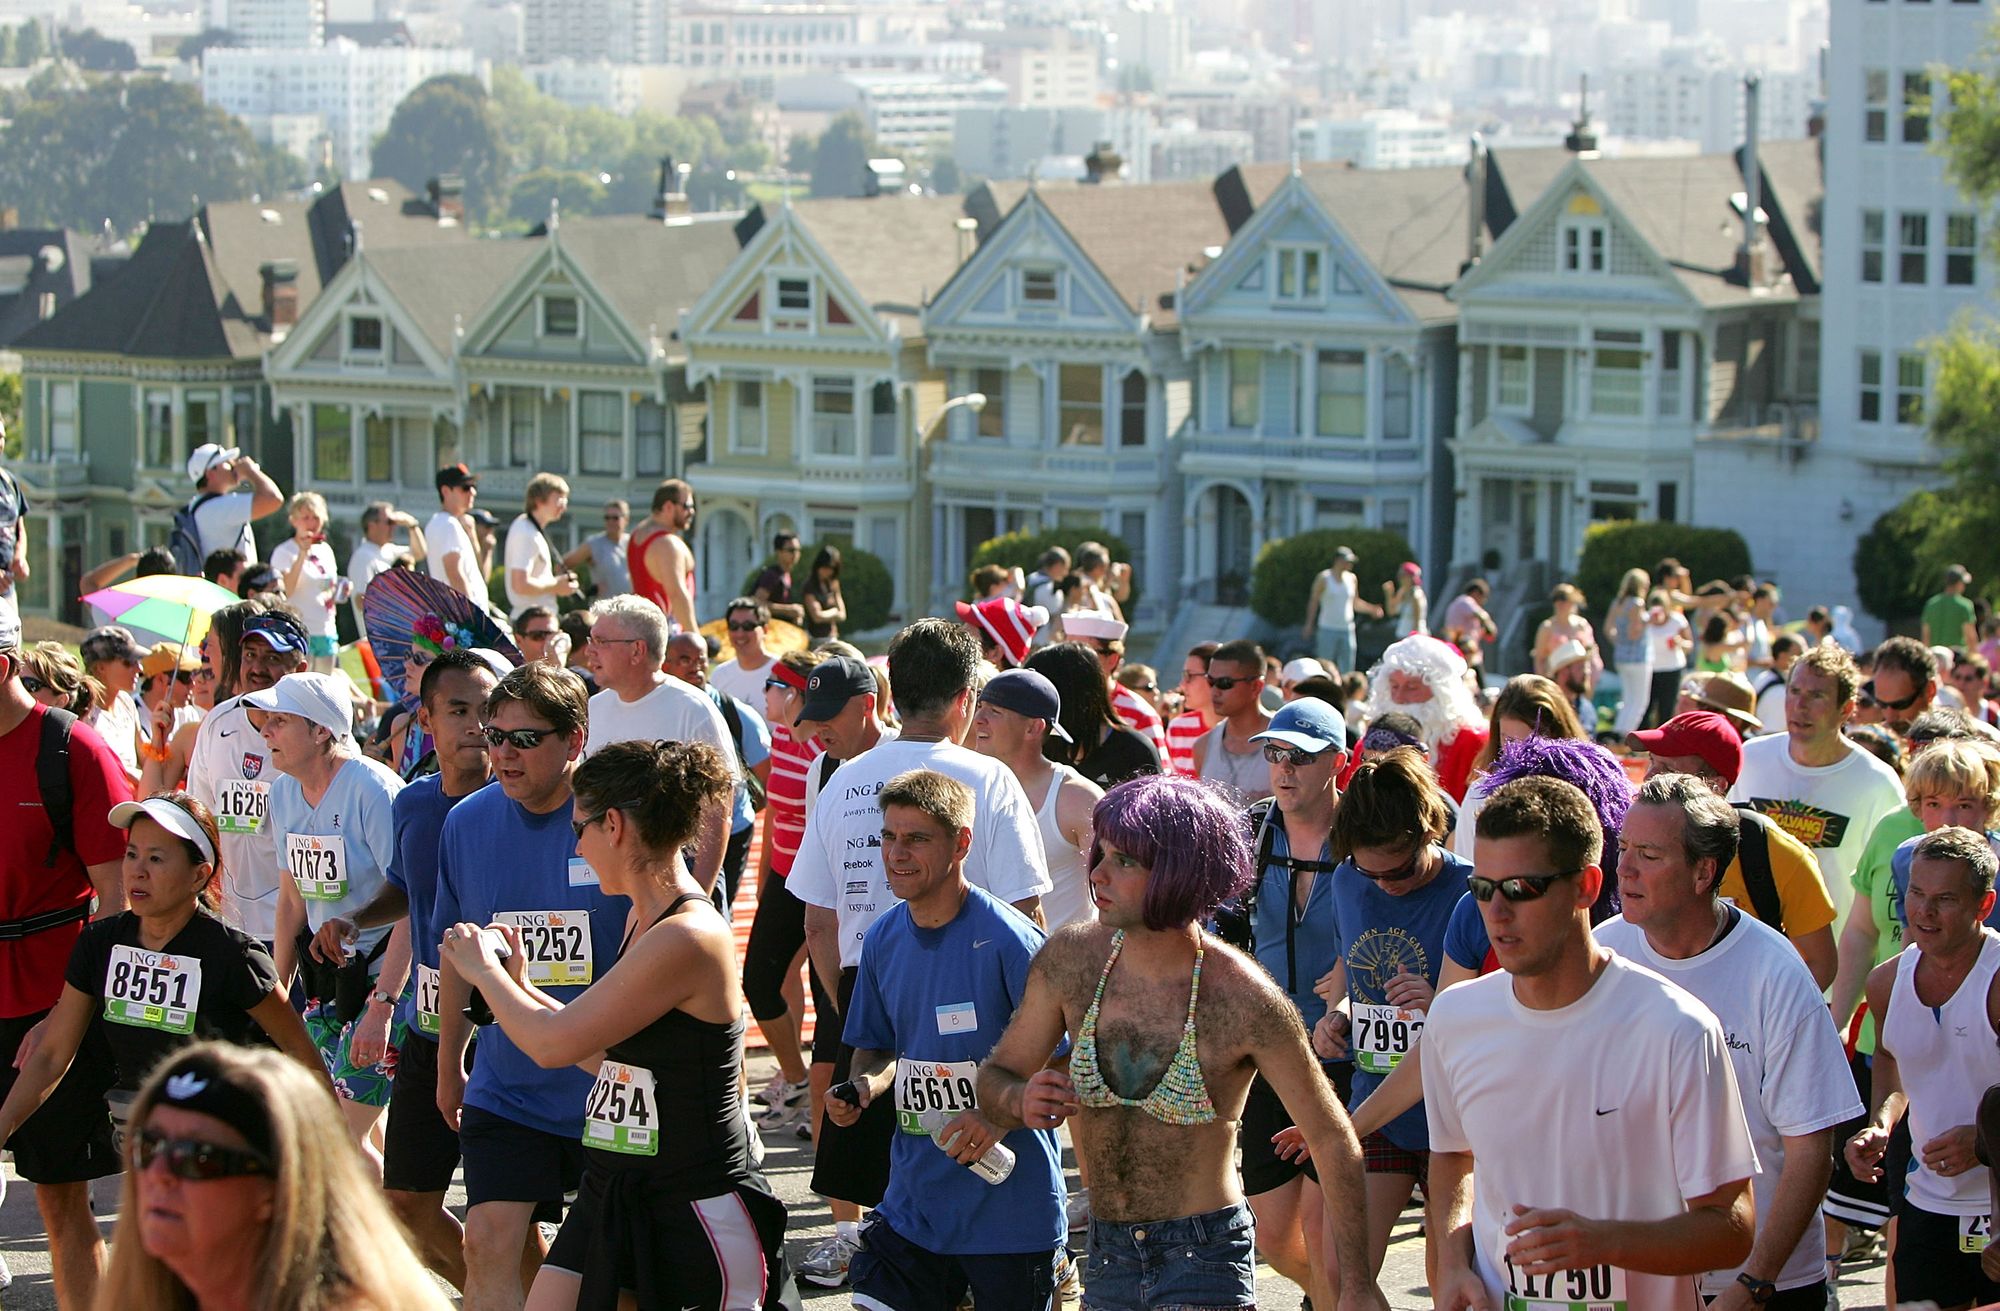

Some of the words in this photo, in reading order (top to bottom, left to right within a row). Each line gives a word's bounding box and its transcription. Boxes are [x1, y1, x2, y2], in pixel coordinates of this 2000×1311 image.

[231, 782, 253, 791] ING
[845, 784, 872, 801] ING
[218, 816, 226, 827] D
[295, 837, 310, 849] ING
[847, 837, 865, 850] NG
[290, 848, 338, 881] 17673
[584, 868, 591, 879] A
[515, 914, 545, 927] ING
[520, 926, 585, 962] 5252
[1348, 927, 1378, 957] GOLDEN
[1387, 926, 1407, 938] AGE
[1409, 935, 1430, 971] GAMES
[129, 950, 157, 967] ING
[112, 961, 188, 1009] 8551
[430, 972, 440, 985] IN
[422, 981, 440, 1015] 17
[421, 1012, 430, 1026] D
[951, 1014, 960, 1026] B
[1367, 1008, 1393, 1020] ING
[601, 1064, 616, 1081] ING
[909, 1064, 933, 1077] ING
[902, 1076, 976, 1111] 15619
[586, 1079, 650, 1126] 8254
[901, 1111, 910, 1127] D
[1966, 1236, 1975, 1248] E
